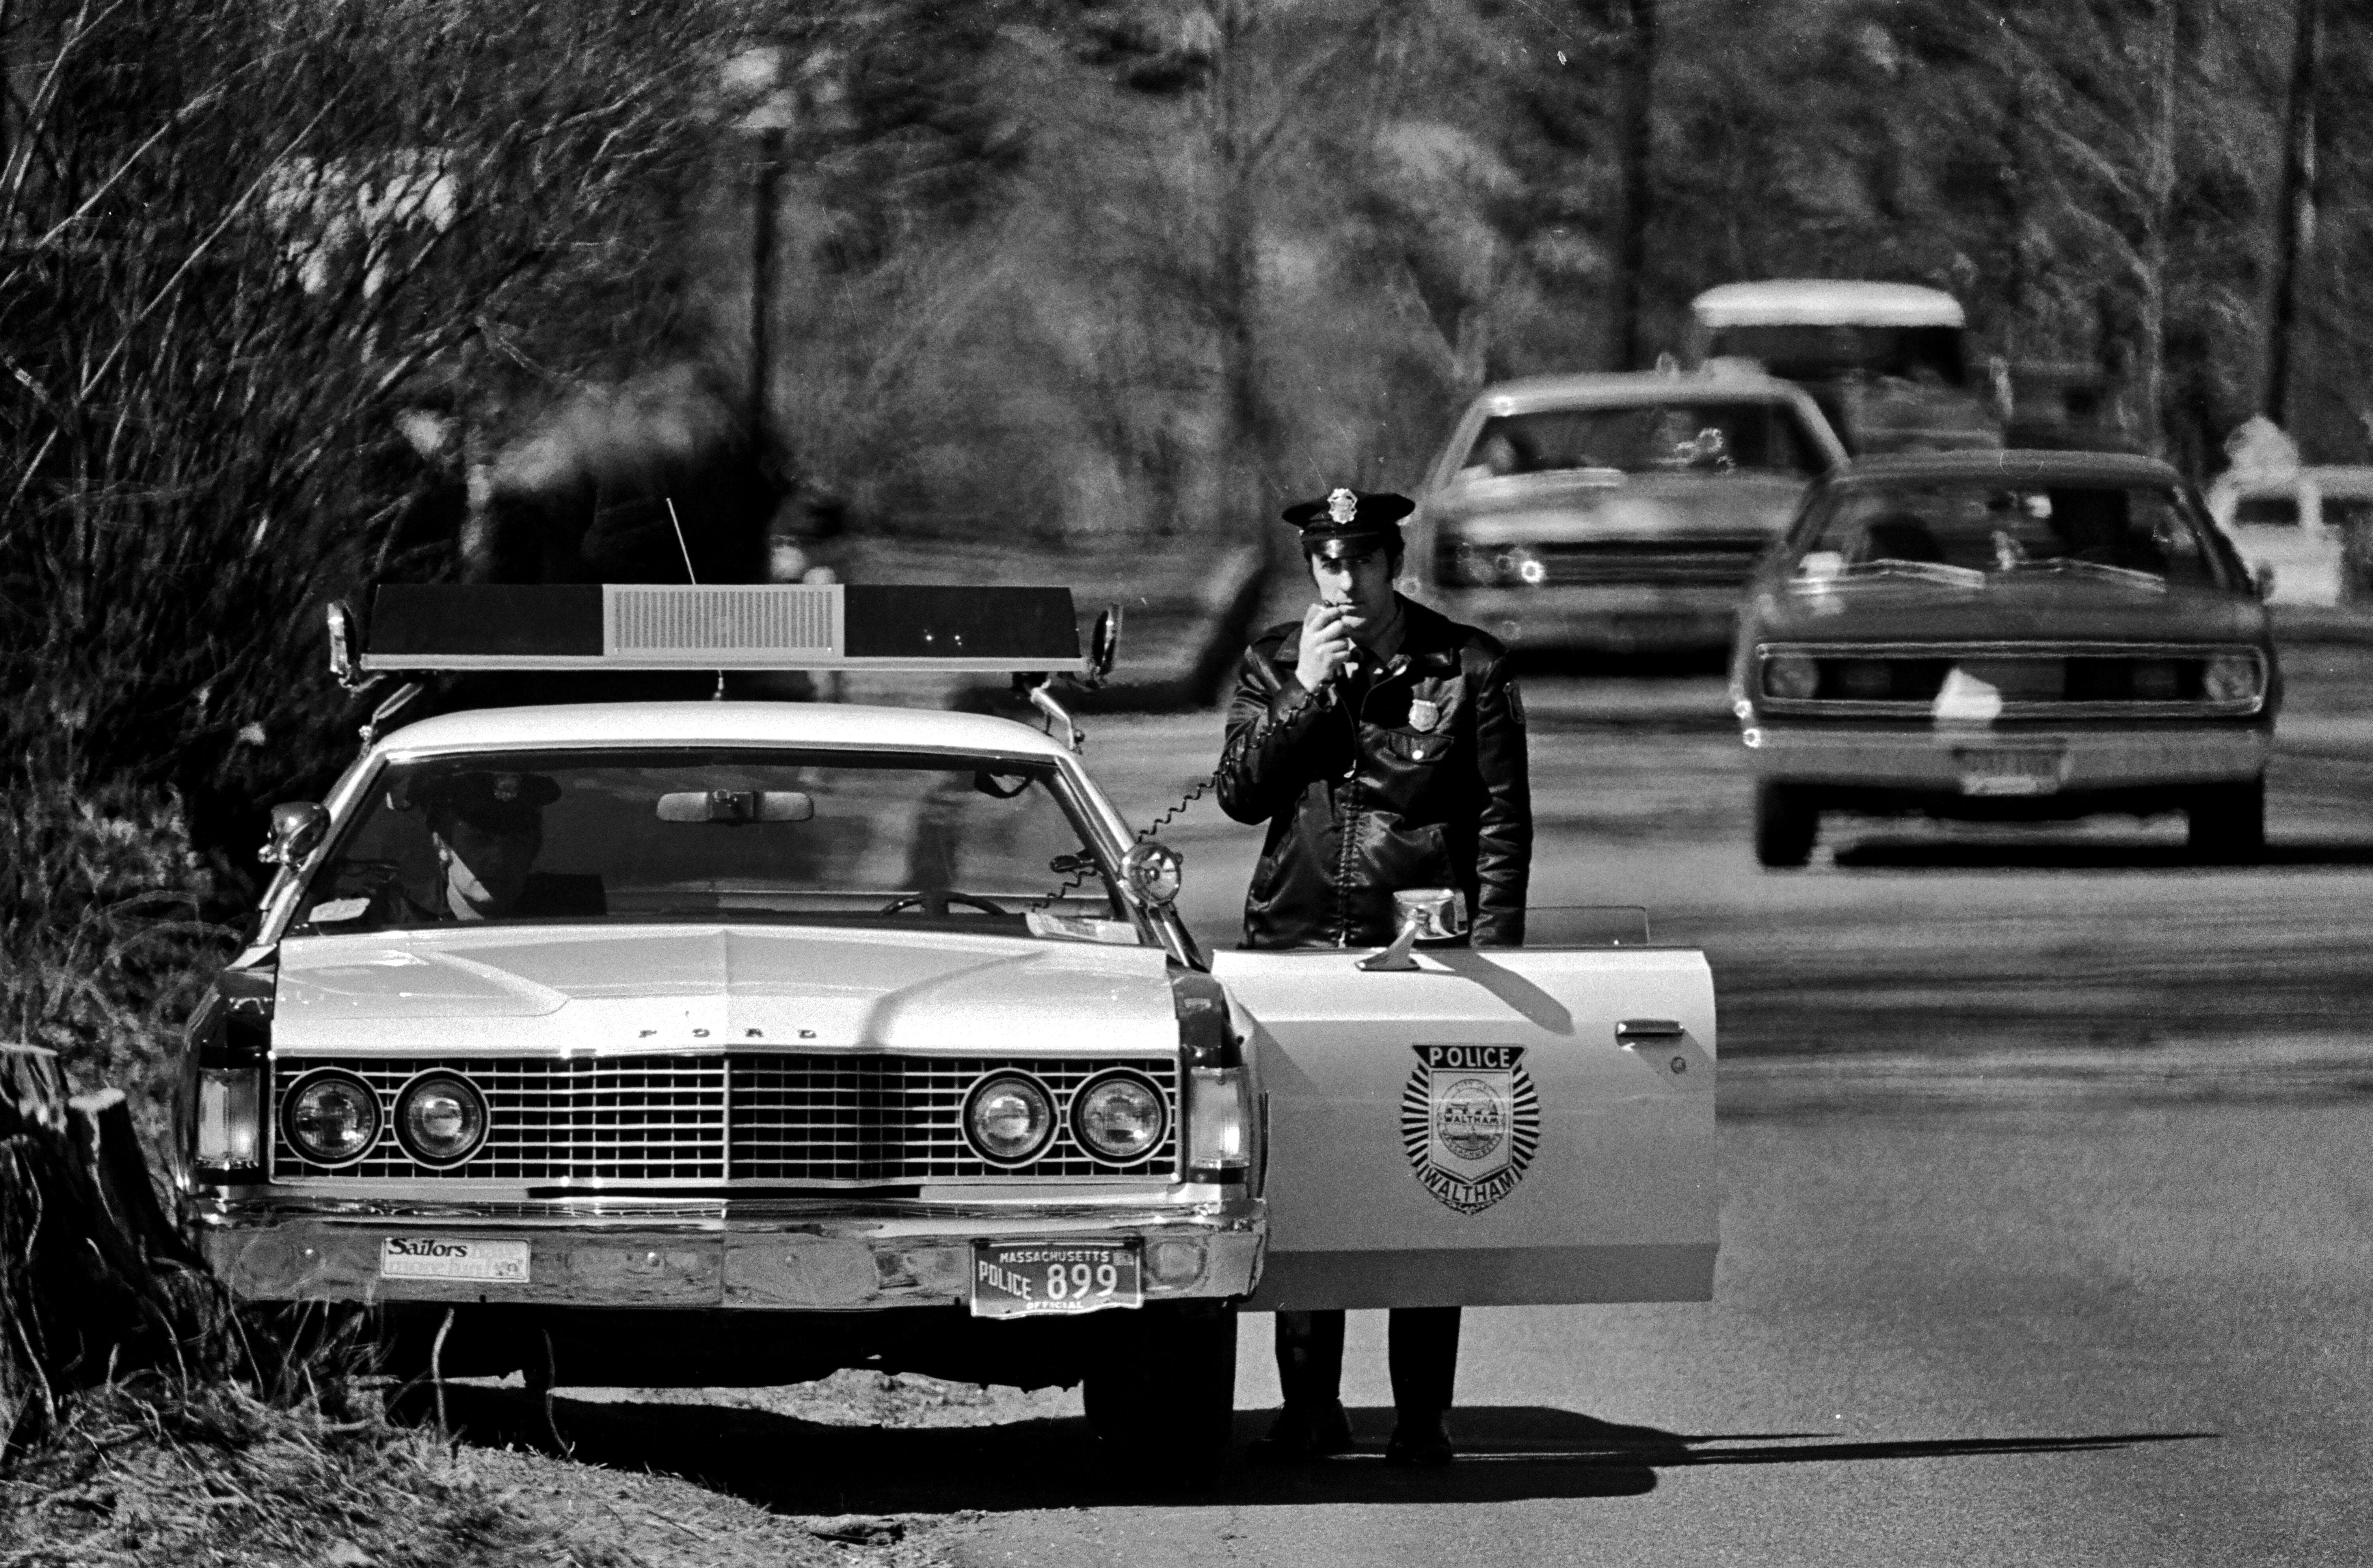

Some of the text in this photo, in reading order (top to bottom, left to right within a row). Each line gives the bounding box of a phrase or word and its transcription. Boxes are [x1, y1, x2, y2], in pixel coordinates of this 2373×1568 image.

[1429, 1047, 1510, 1068] POLICE
[1444, 1115, 1499, 1124] WALTHAM
[1424, 1166, 1515, 1202] WALTHAM
[388, 1238, 468, 1257] Sailors
[999, 1250, 1109, 1263] MASSACHUSETTS
[979, 1260, 1117, 1300] POLICE 899
[1026, 1301, 1084, 1310] OFFICIAL
